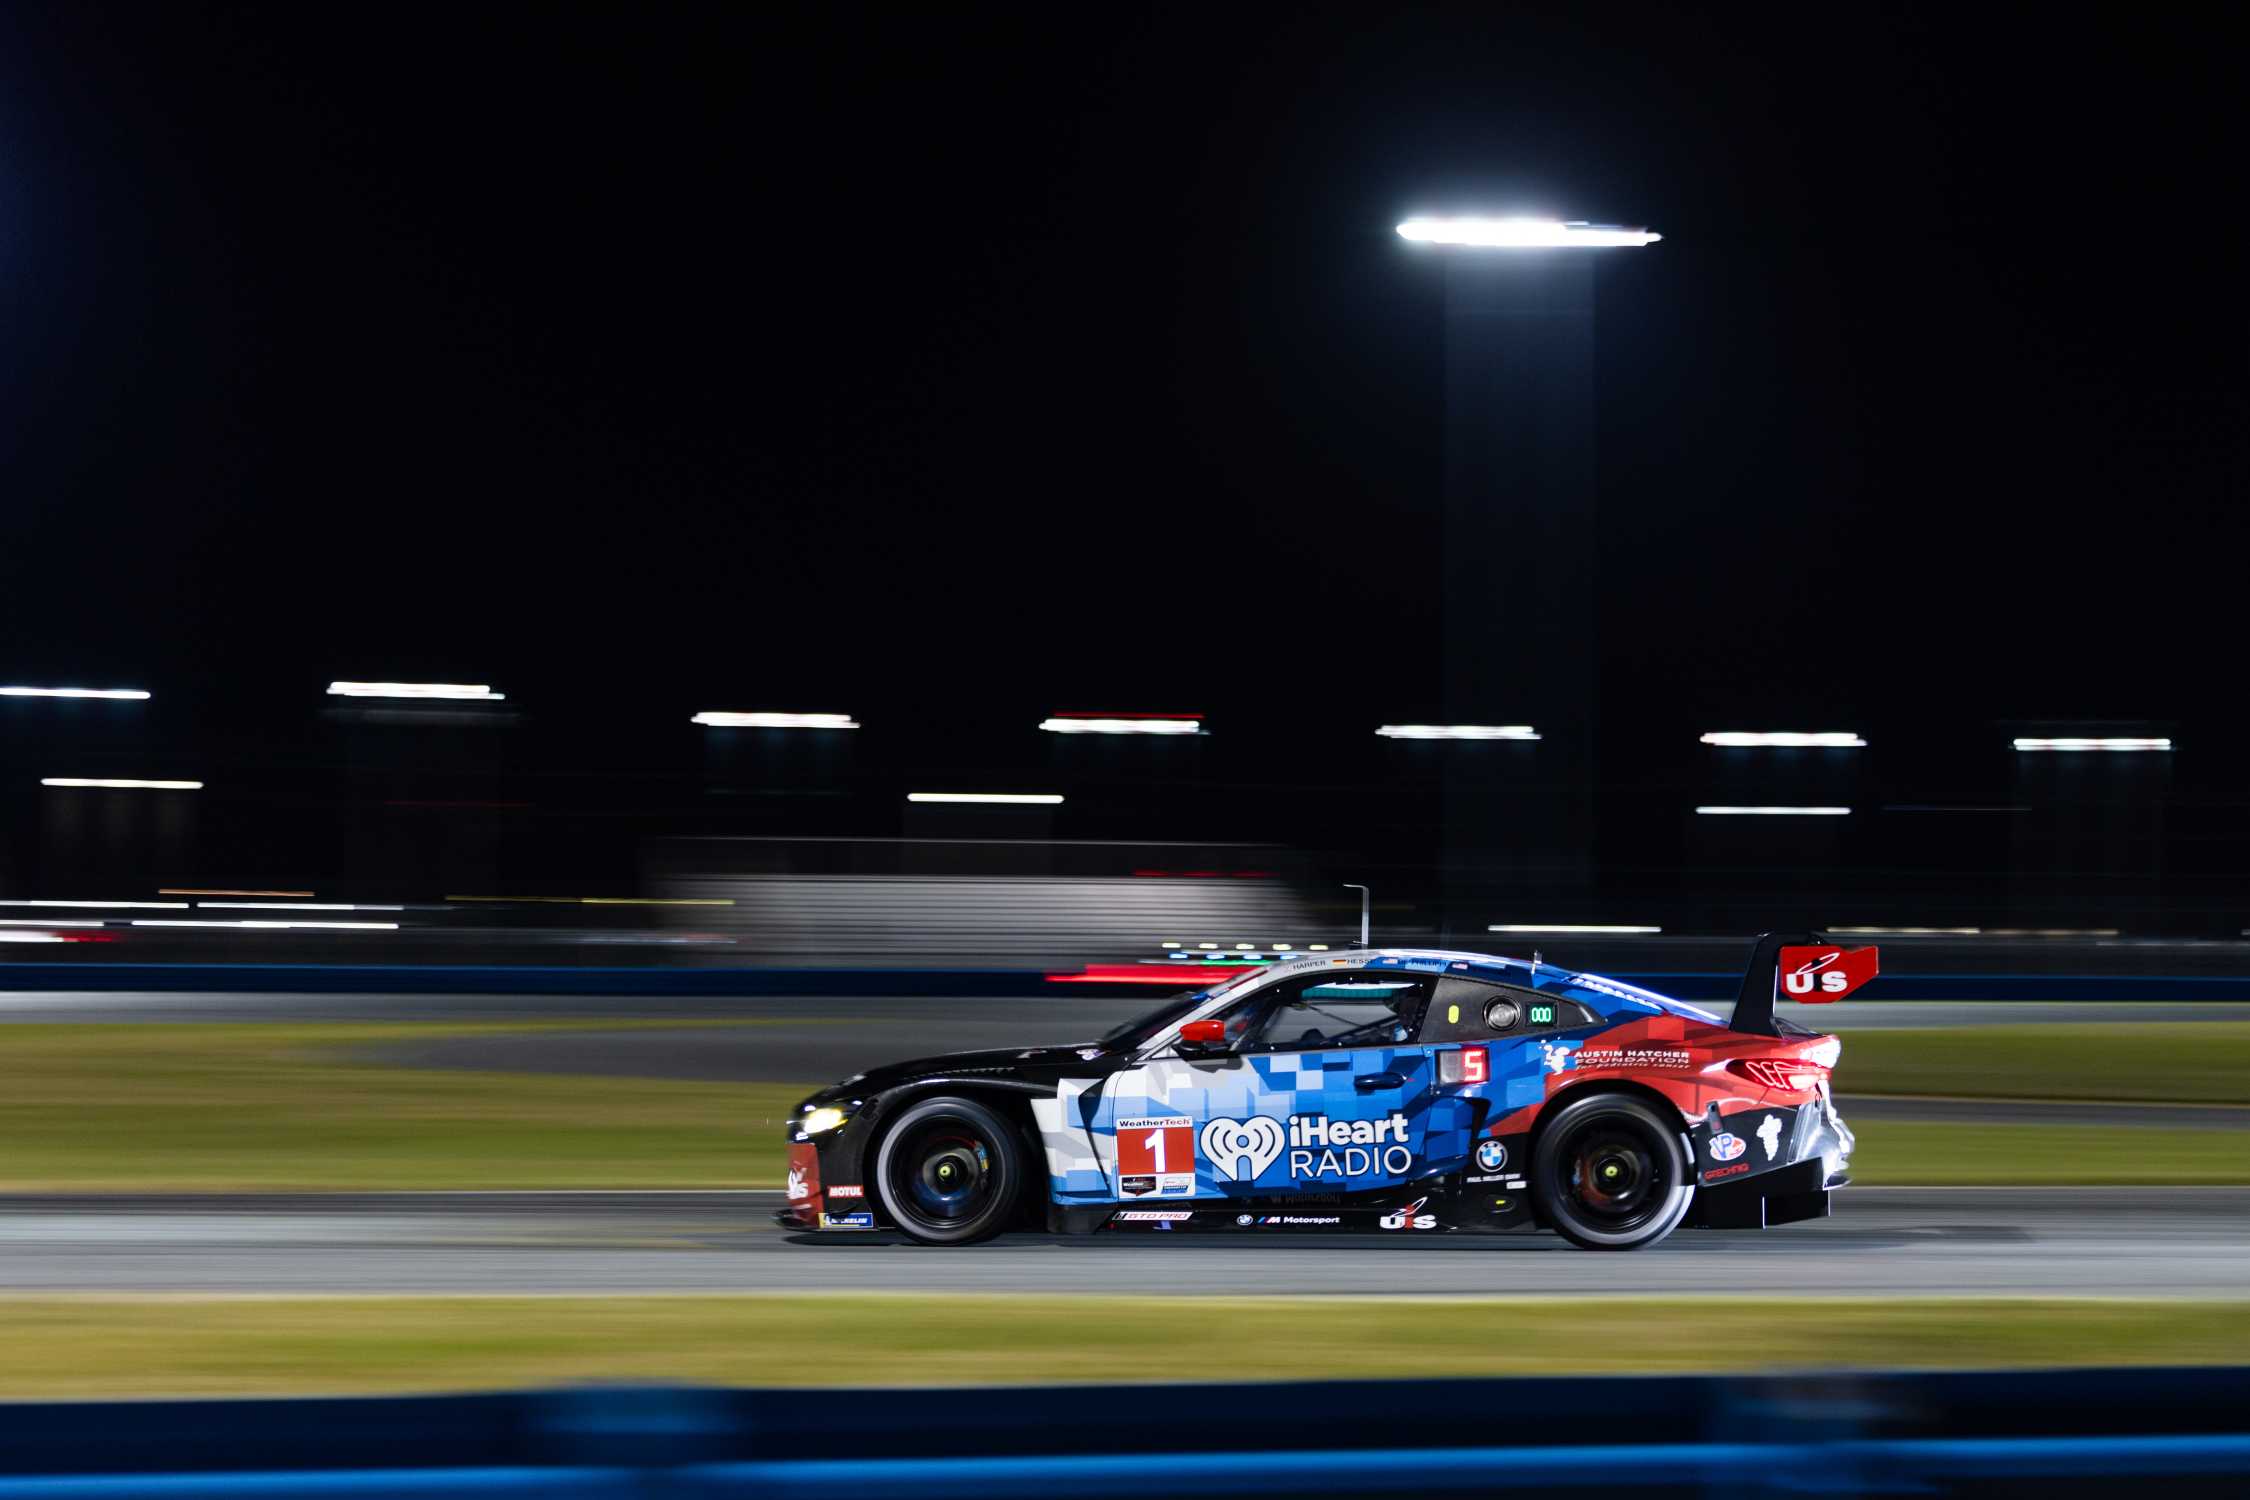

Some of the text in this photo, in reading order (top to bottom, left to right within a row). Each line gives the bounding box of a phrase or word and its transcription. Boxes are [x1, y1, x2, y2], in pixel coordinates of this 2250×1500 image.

[1574, 1050, 1690, 1058] AUSTIN HATCHER
[1464, 1051, 1483, 1081] 5
[1119, 1118, 1190, 1127] WeatherTech
[1290, 1114, 1409, 1147] iHeart
[1145, 1129, 1166, 1173] 1
[1290, 1145, 1413, 1178] RADIO
[829, 1186, 863, 1197] MOTUL
[1283, 1216, 1340, 1224] Motorsport
